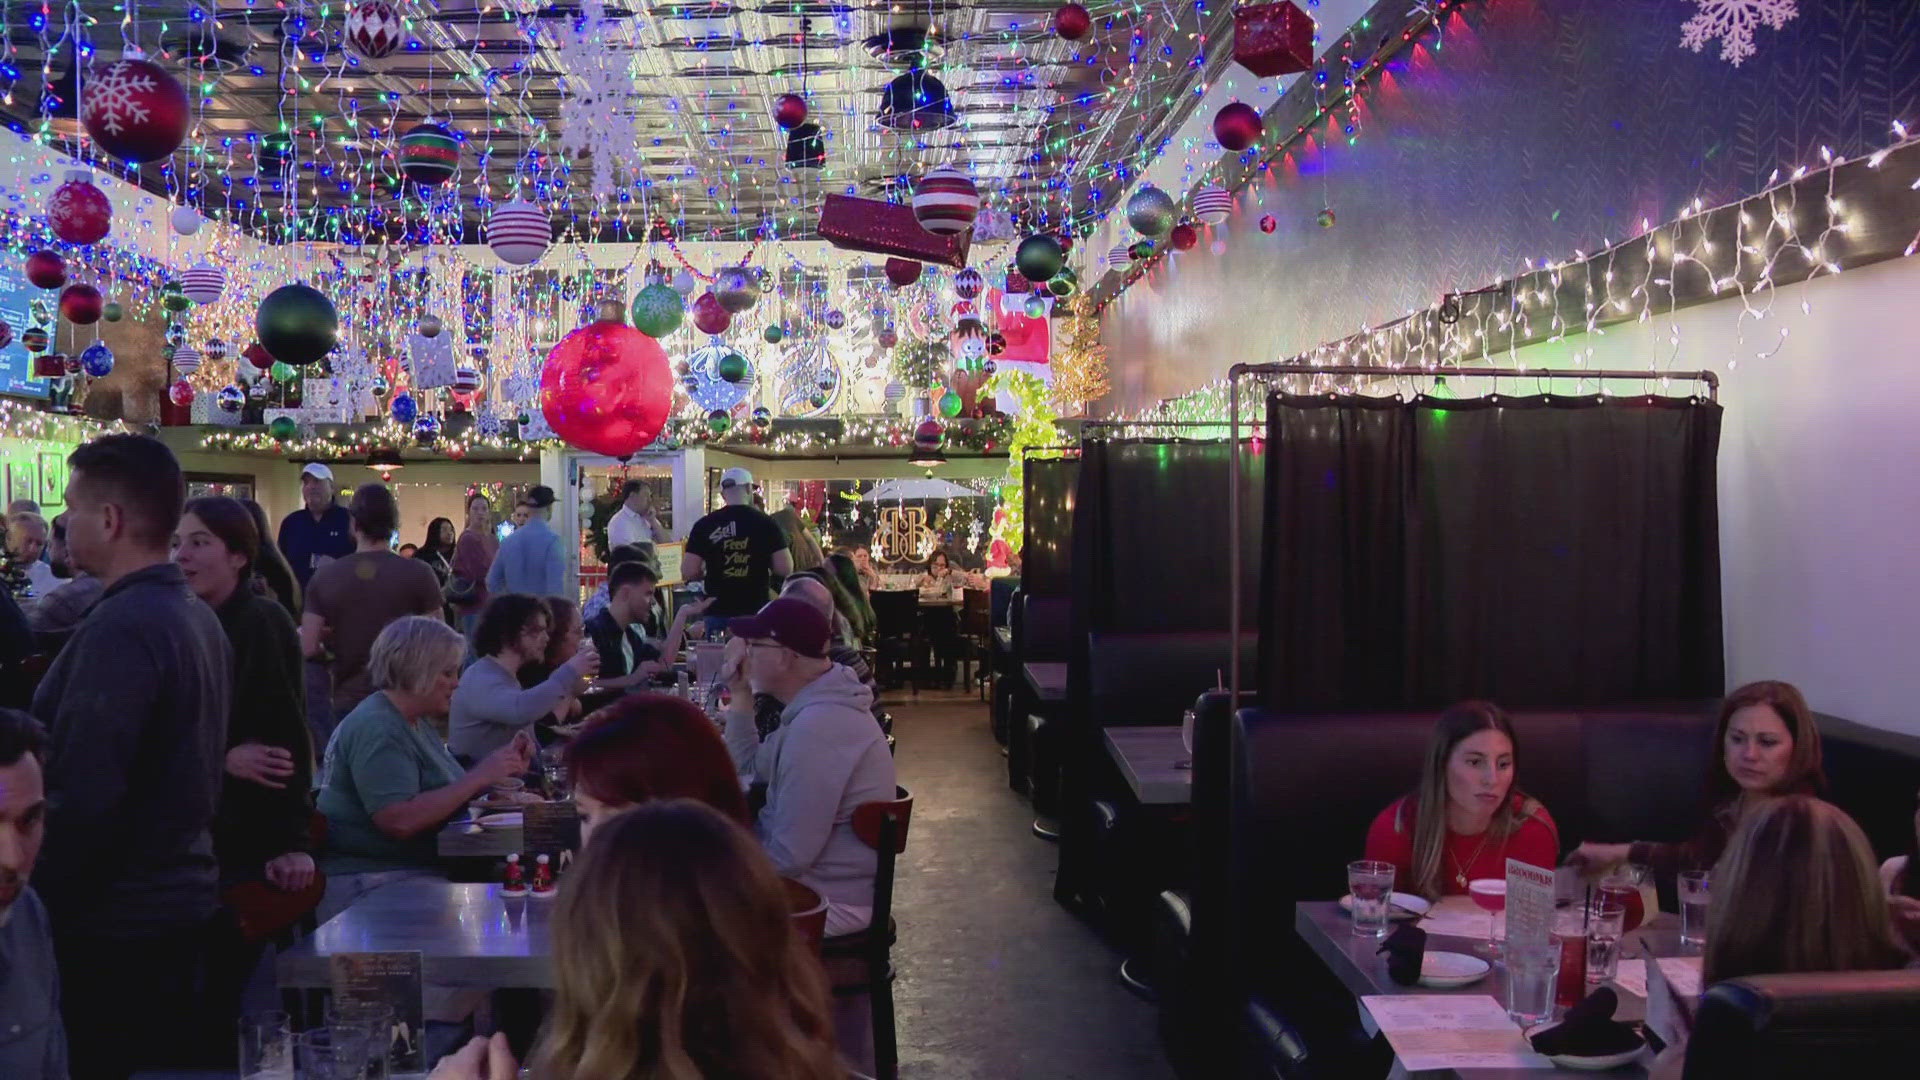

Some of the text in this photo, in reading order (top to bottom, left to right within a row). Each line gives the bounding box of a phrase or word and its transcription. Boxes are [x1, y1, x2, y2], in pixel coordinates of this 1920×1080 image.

[709, 521, 736, 543] Sell
[724, 537, 749, 551] Feed
[725, 552, 751, 565] Your
[724, 565, 749, 577] Soul
